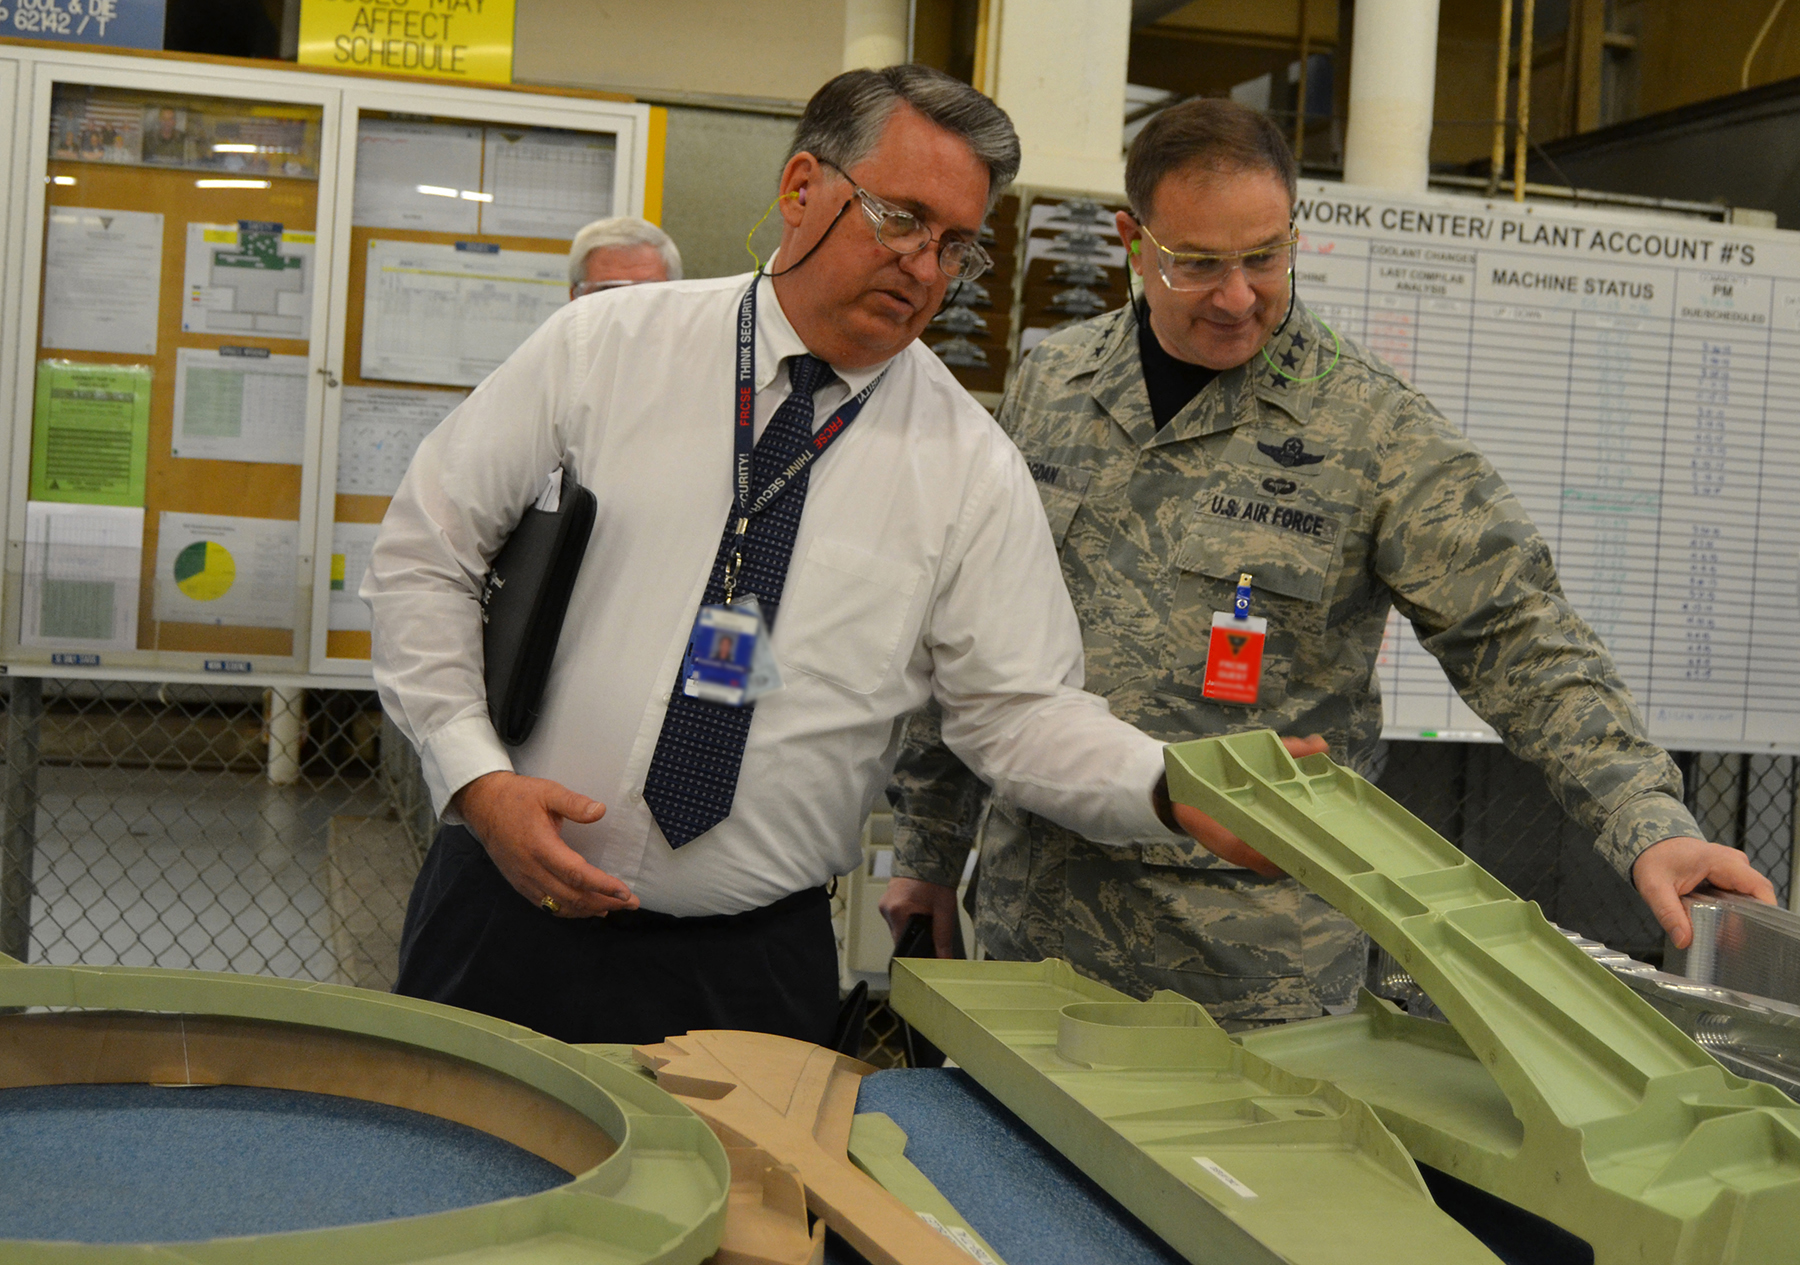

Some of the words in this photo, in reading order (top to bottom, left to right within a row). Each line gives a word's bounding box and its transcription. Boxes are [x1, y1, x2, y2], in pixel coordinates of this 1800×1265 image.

[14, 9, 71, 34] 62142
[96, 15, 110, 37] T
[352, 7, 452, 41] AFFECT
[333, 34, 468, 74] SCHEDULE
[1294, 200, 1371, 228] WORK
[1380, 207, 1495, 241] CENTER/
[1501, 220, 1584, 249] PLANT
[1590, 229, 1714, 261] ACCOUNT
[1492, 268, 1579, 294] MACHINE
[1583, 276, 1655, 300] STATUS
[1712, 283, 1734, 299] PM
[740, 345, 751, 381] THINK
[740, 387, 751, 427] FRCSE
[812, 416, 844, 450] FRCSE
[738, 453, 749, 508] CURITY!
[782, 449, 814, 479] THINK
[1027, 461, 1060, 485] GDAN
[750, 477, 786, 514] SECUR
[1211, 495, 1238, 517] U.S.
[1241, 502, 1270, 523] AIR
[1272, 506, 1325, 536] FORCE
